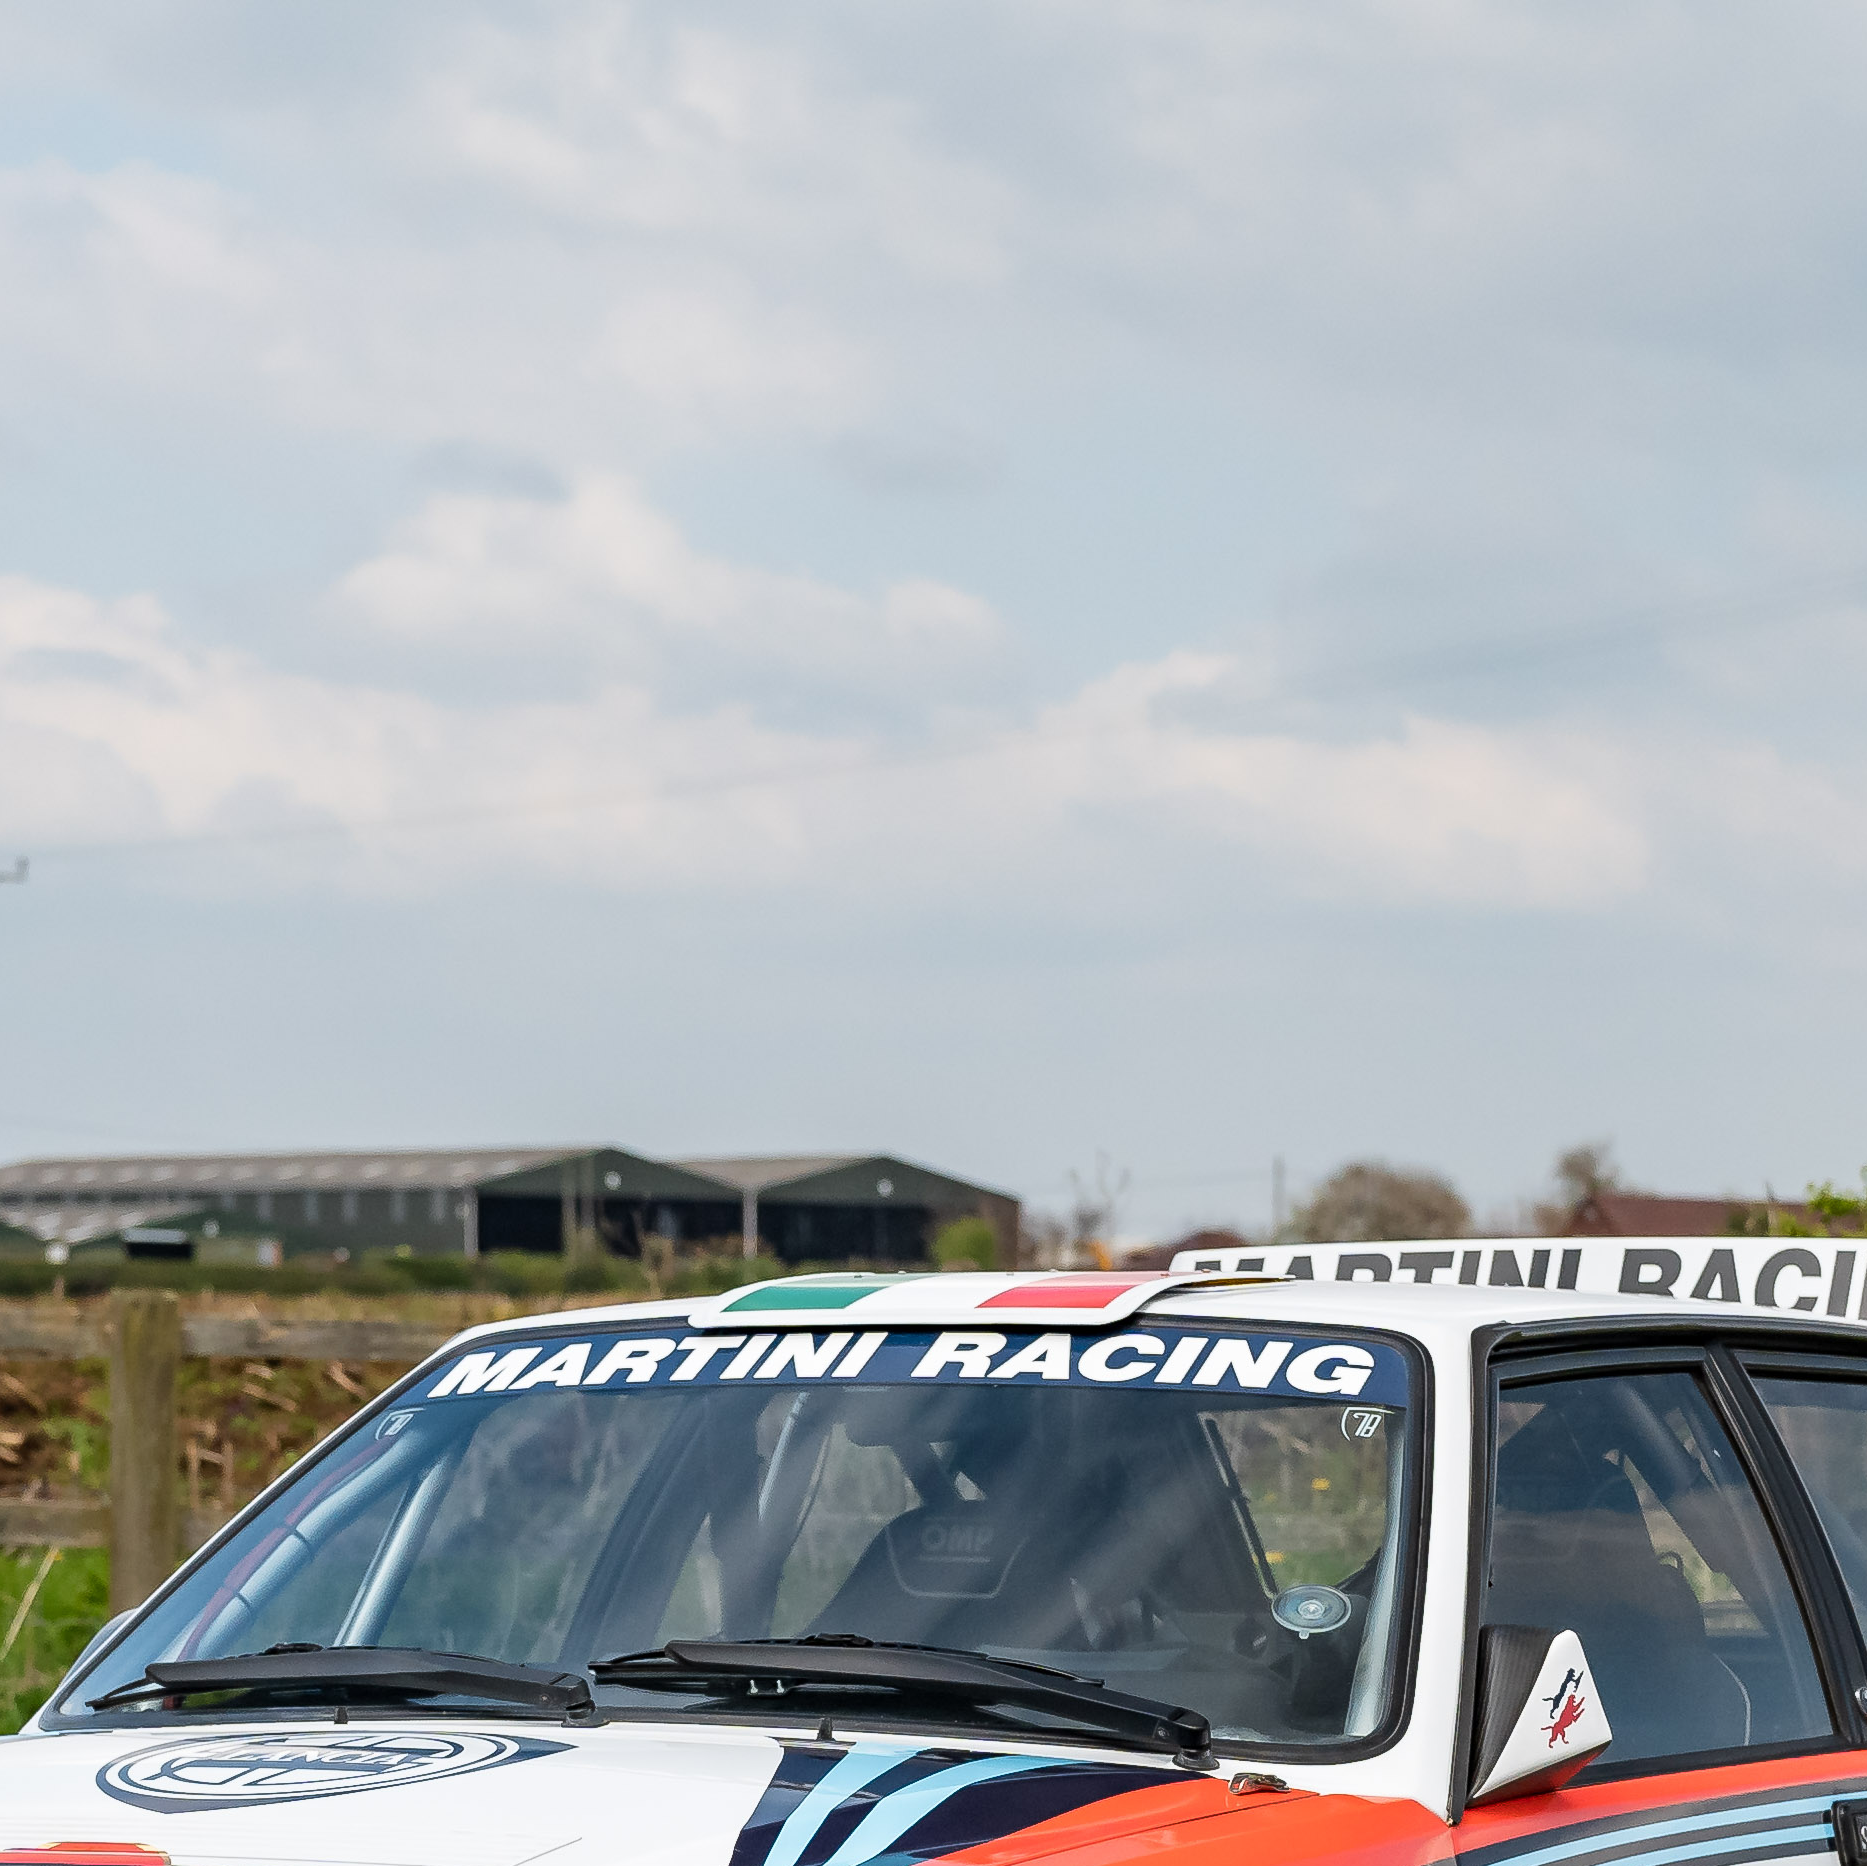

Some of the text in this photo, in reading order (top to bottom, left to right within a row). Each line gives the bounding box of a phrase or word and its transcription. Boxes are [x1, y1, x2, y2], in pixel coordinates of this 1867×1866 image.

[1195, 1249, 1582, 1291] RTINI
[427, 1331, 1375, 1398] MARTINI RACING
